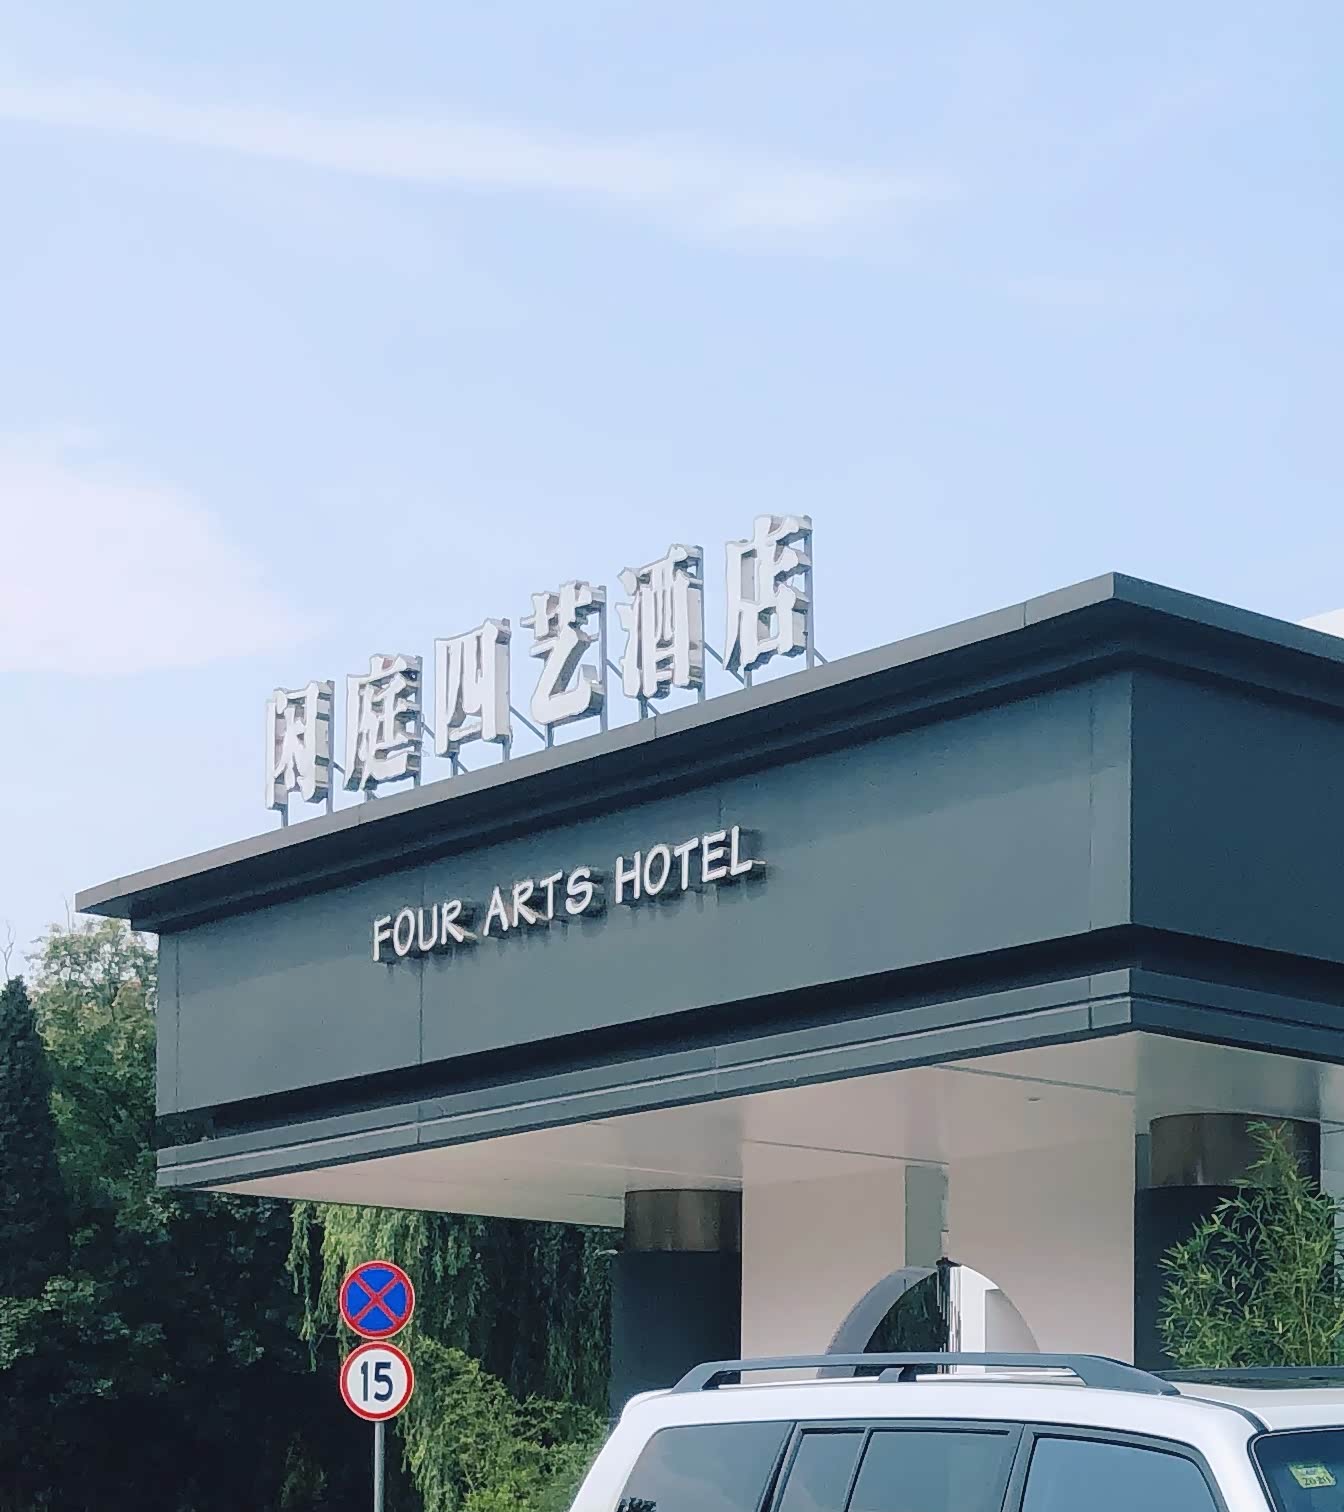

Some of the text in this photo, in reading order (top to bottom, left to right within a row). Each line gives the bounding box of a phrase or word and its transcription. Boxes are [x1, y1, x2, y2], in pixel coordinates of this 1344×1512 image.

[264, 514, 812, 811] 闲庭四艺酒店
[372, 825, 756, 962] FOUR ARTS HOTEL
[360, 1361, 394, 1402] 15
